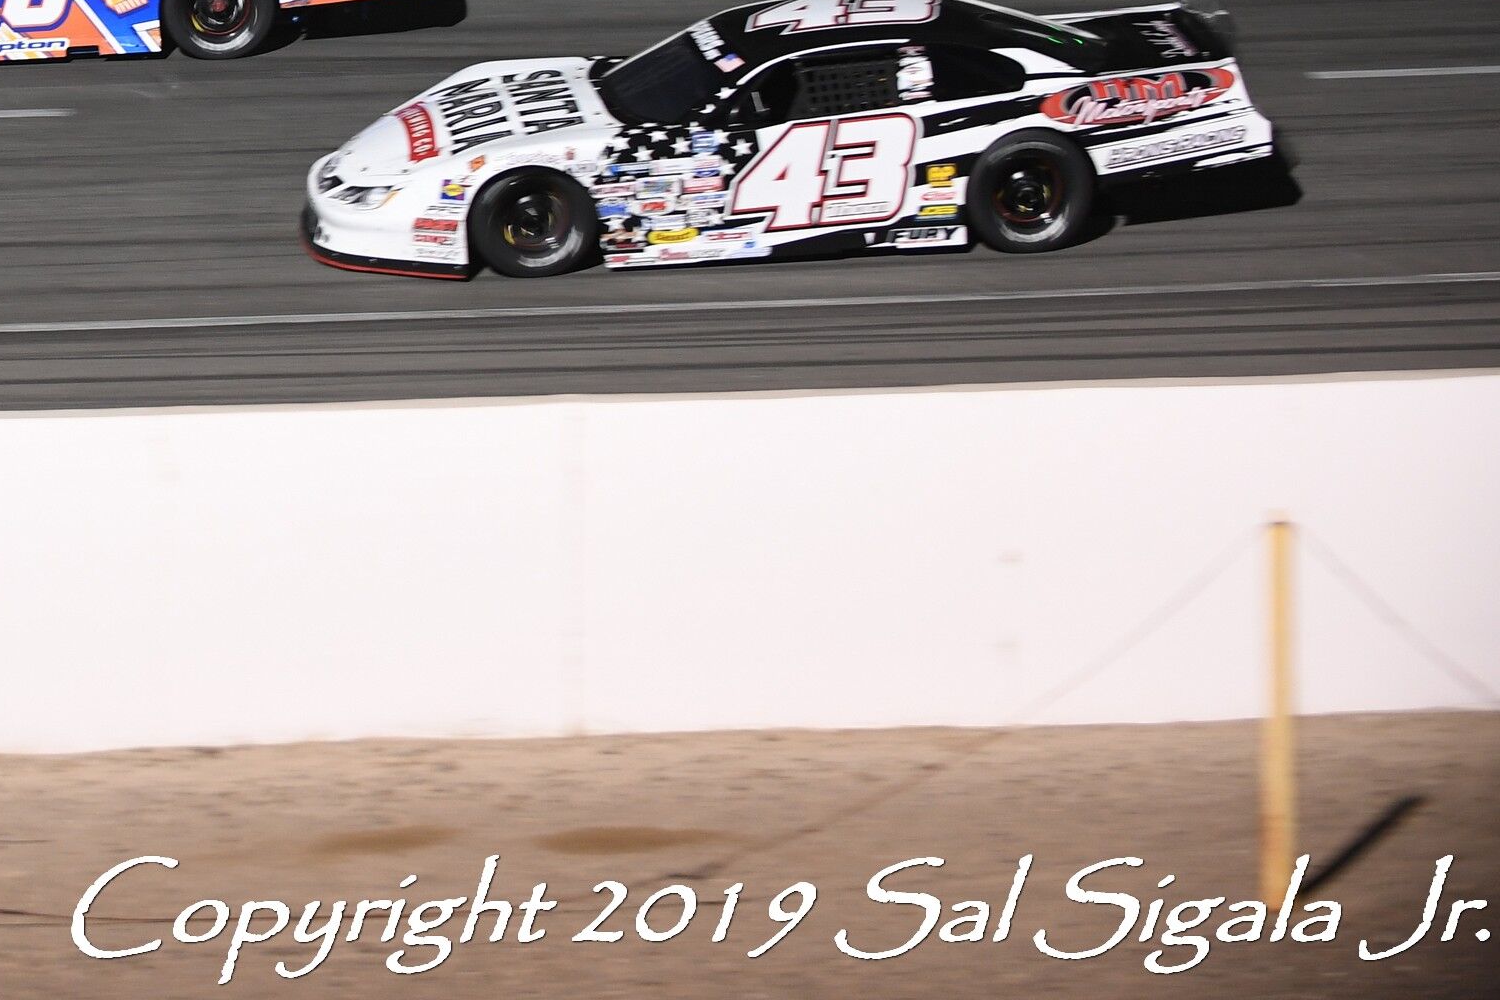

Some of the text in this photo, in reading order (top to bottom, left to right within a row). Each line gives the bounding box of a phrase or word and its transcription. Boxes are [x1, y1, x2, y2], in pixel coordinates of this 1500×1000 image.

[426, 78, 515, 156] MARIA
[502, 69, 586, 136] SANTA
[724, 112, 922, 235] 43
[886, 226, 959, 244] FURY
